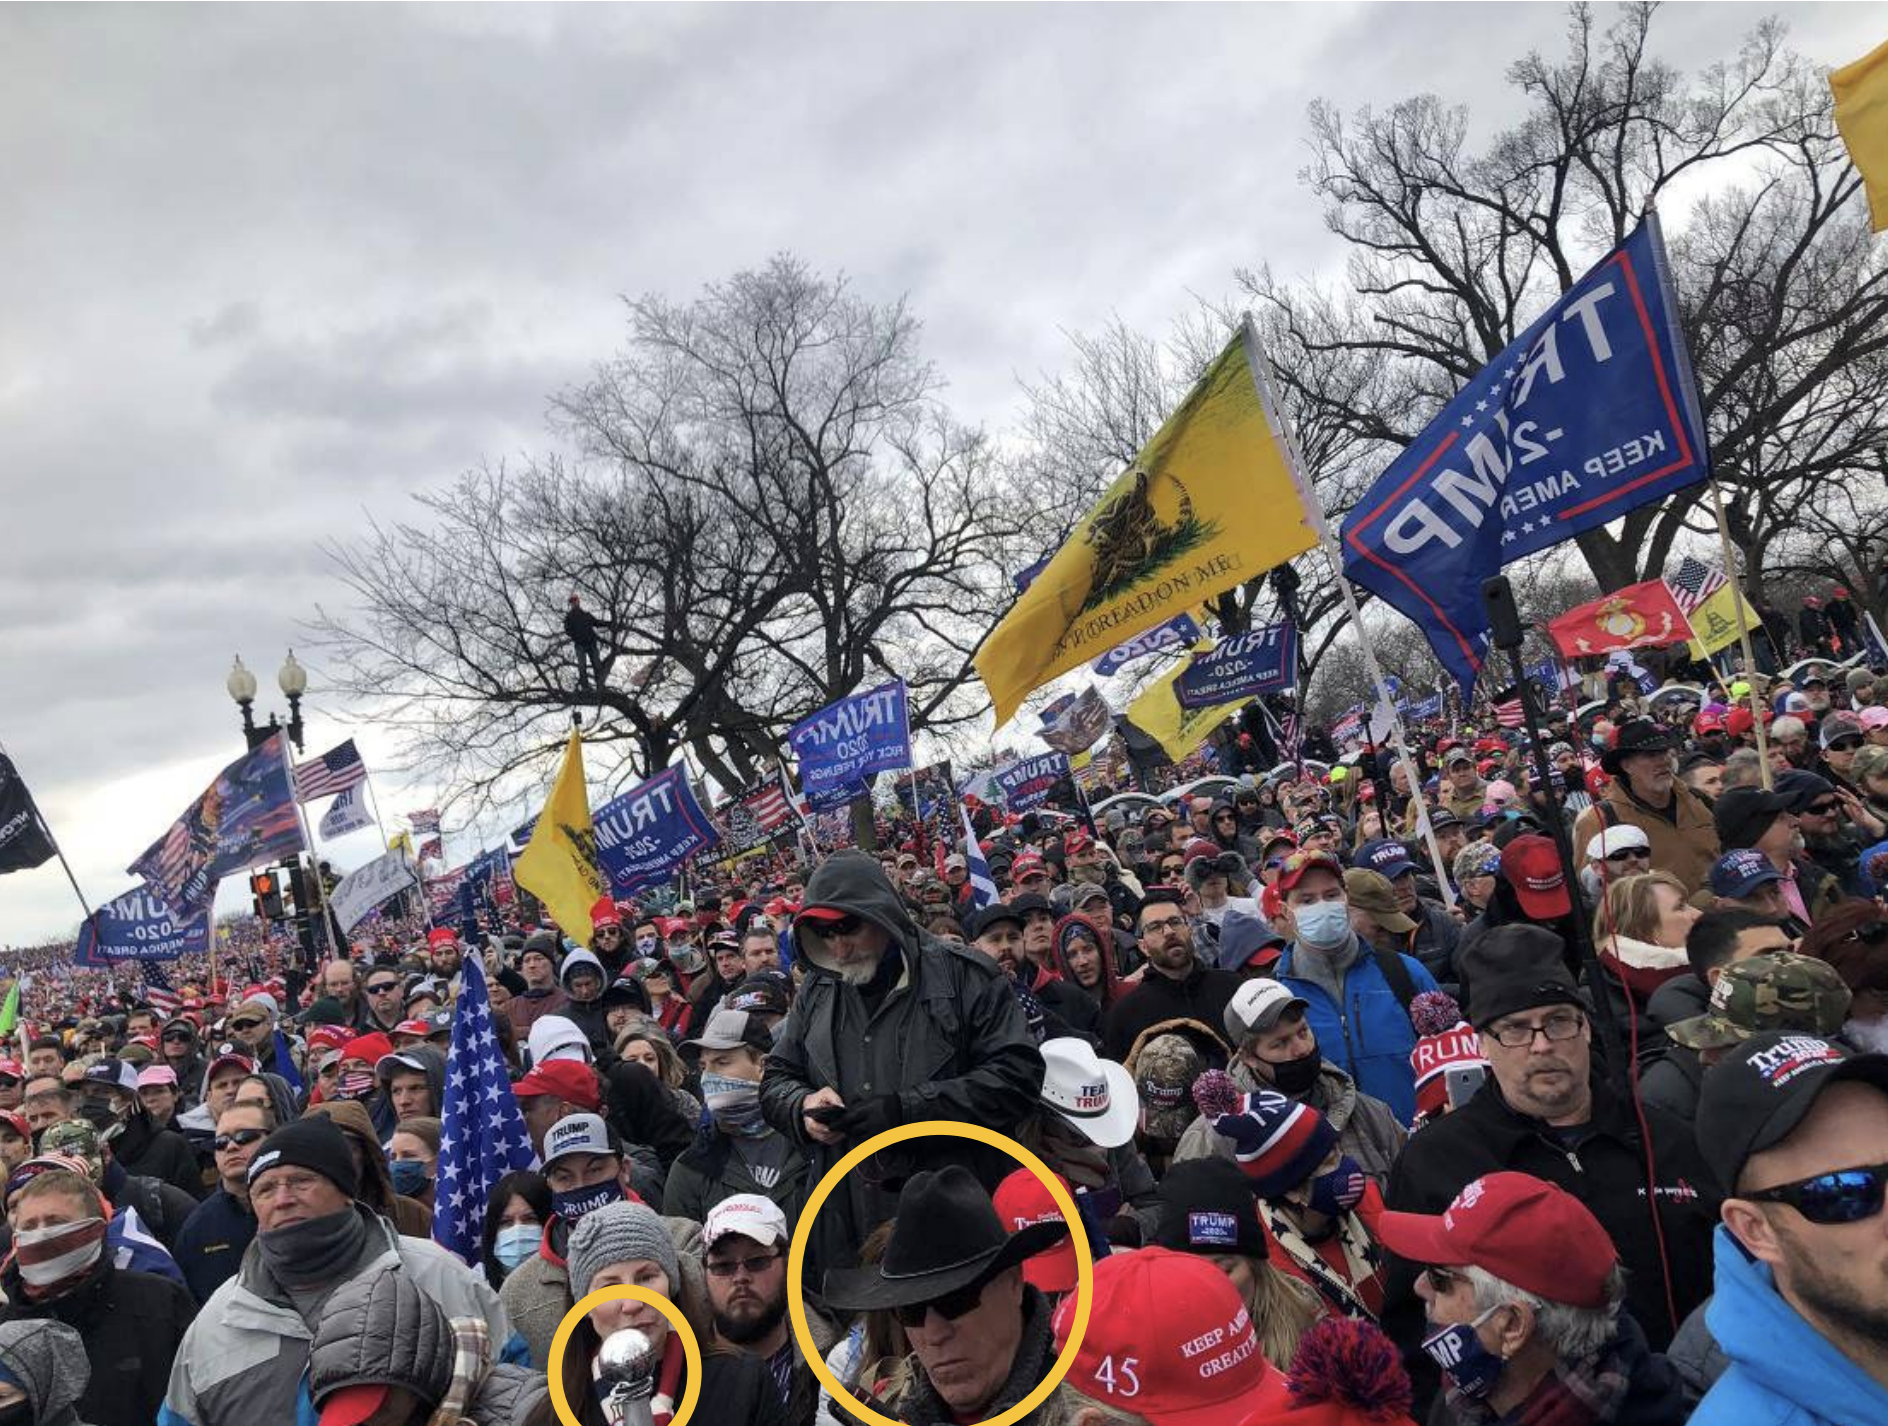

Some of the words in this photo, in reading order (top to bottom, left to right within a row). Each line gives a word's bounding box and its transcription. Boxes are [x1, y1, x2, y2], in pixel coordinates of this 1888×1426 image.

[1157, 573, 1190, 600] ON
[1196, 554, 1229, 581] ME
[1746, 1035, 1829, 1071] Trump
[1146, 1080, 1183, 1096] Trump
[553, 1122, 589, 1141] TRUMP
[564, 1191, 609, 1215] TRUMP
[1192, 1215, 1235, 1228] TRUMP
[1182, 1328, 1223, 1358] KEEP
[1095, 1355, 1140, 1397] 45
